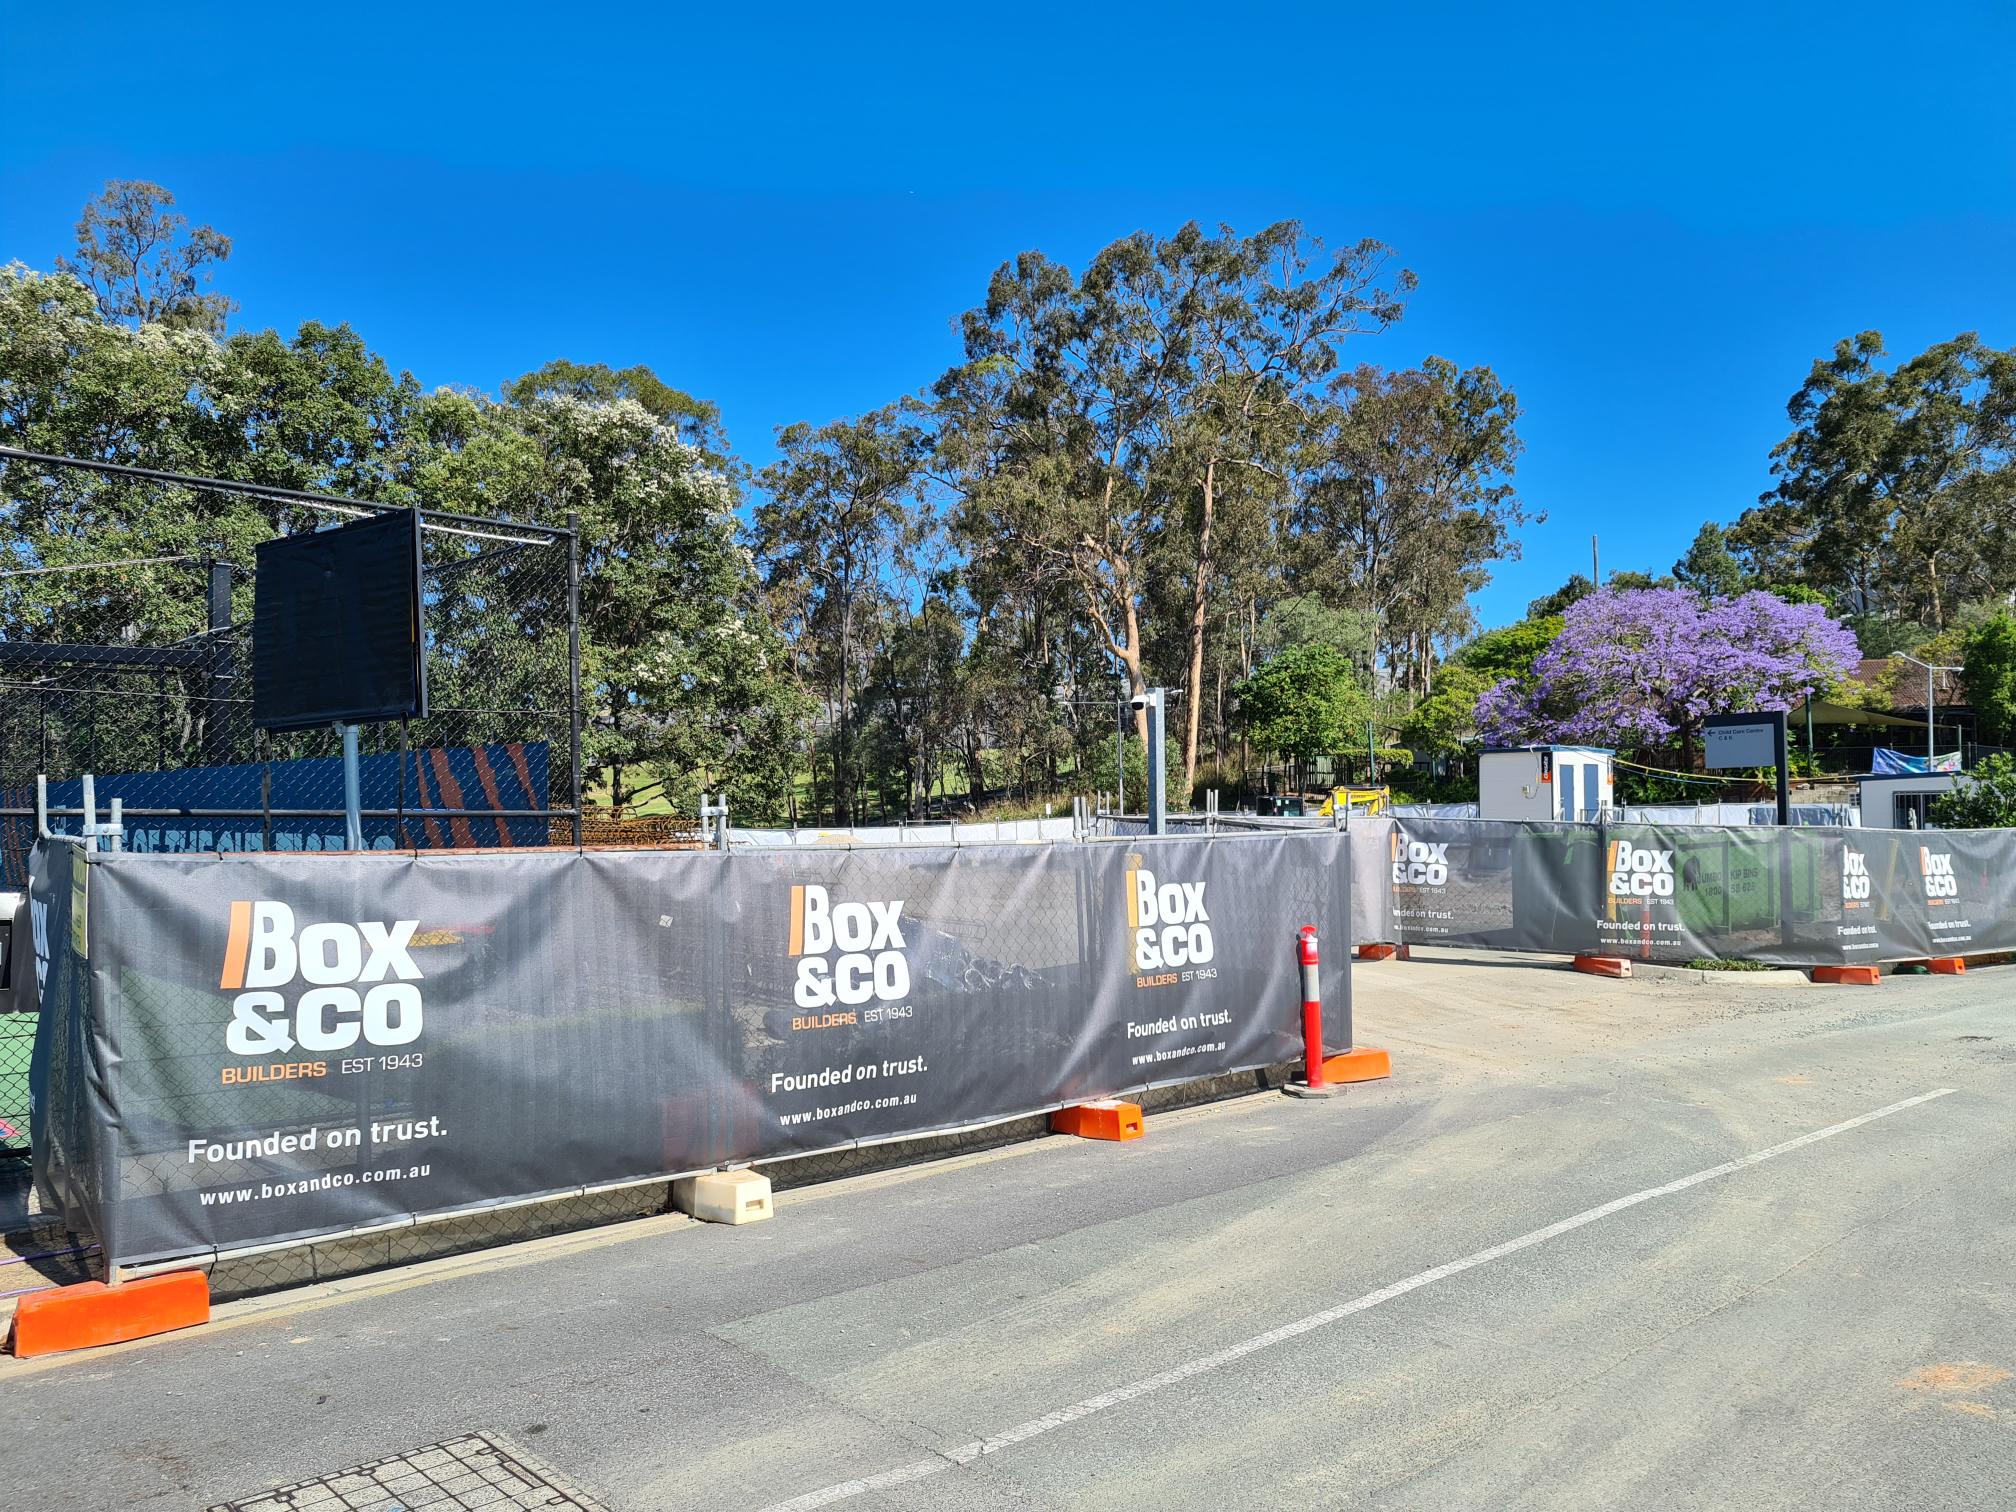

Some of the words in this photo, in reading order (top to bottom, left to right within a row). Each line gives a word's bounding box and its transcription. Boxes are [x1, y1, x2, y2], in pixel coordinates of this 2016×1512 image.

[1428, 909, 1454, 920] trust.
[1596, 919, 1641, 931] Founded
[1642, 922, 1656, 931] on
[1600, 937, 1681, 946] www.boxandco.com.au
[1136, 973, 1178, 989] BUILDERS
[1181, 970, 1195, 982] EST
[1195, 967, 1218, 981] 1943
[792, 1011, 857, 1031] BUILDERS
[864, 1008, 884, 1023] EST
[886, 1005, 913, 1020] 1943
[1127, 1015, 1177, 1039] Founded
[1180, 1014, 1198, 1029] on
[1200, 1008, 1233, 1027] trust.
[1132, 1040, 1226, 1066] www.boxandco.com.au
[221, 1061, 327, 1085] BUILDERS
[341, 1057, 375, 1074] EST
[378, 1052, 423, 1071] 1943
[770, 1064, 851, 1093] Founded
[856, 1063, 877, 1081] on
[882, 1055, 928, 1078] trust.
[780, 1093, 917, 1126] www.boxandco.com.au
[187, 1127, 318, 1164] Founded
[326, 1127, 362, 1148] on
[370, 1115, 448, 1144] trust.
[200, 1164, 431, 1206] www.boxandco.com.au
